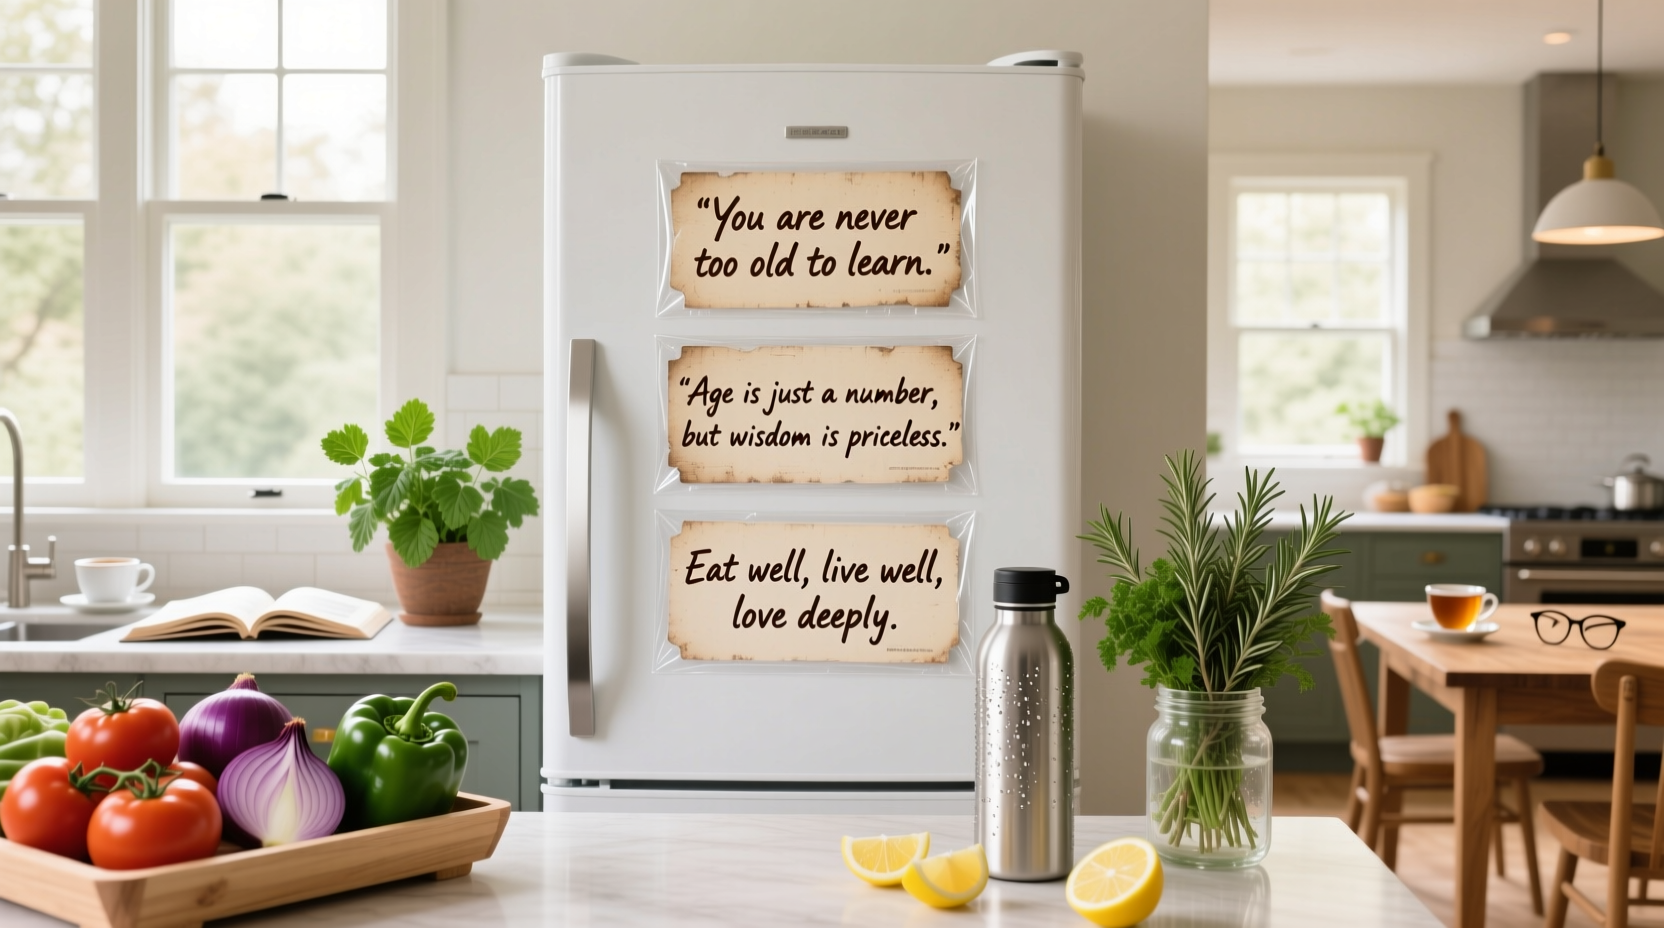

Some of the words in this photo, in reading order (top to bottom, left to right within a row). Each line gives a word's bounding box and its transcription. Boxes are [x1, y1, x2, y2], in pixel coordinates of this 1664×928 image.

[696, 195, 765, 242] “You
[776, 209, 825, 231] are
[835, 208, 918, 231] never
[694, 247, 738, 278] too
[749, 241, 799, 277] old
[806, 246, 837, 277] to
[847, 240, 951, 276] learn.”
[679, 375, 734, 418] “Age
[743, 381, 761, 404] is
[762, 380, 815, 416] just
[821, 388, 838, 404] a
[845, 376, 938, 411] number,
[681, 419, 722, 448] but
[729, 419, 811, 447] wisdom
[821, 425, 840, 447] is
[844, 418, 961, 459] priceless.”
[685, 548, 740, 585] Eat
[748, 548, 809, 590] well,
[822, 548, 870, 584] live
[880, 548, 943, 590] well,
[732, 593, 788, 630] love
[797, 594, 898, 646] deeply.
